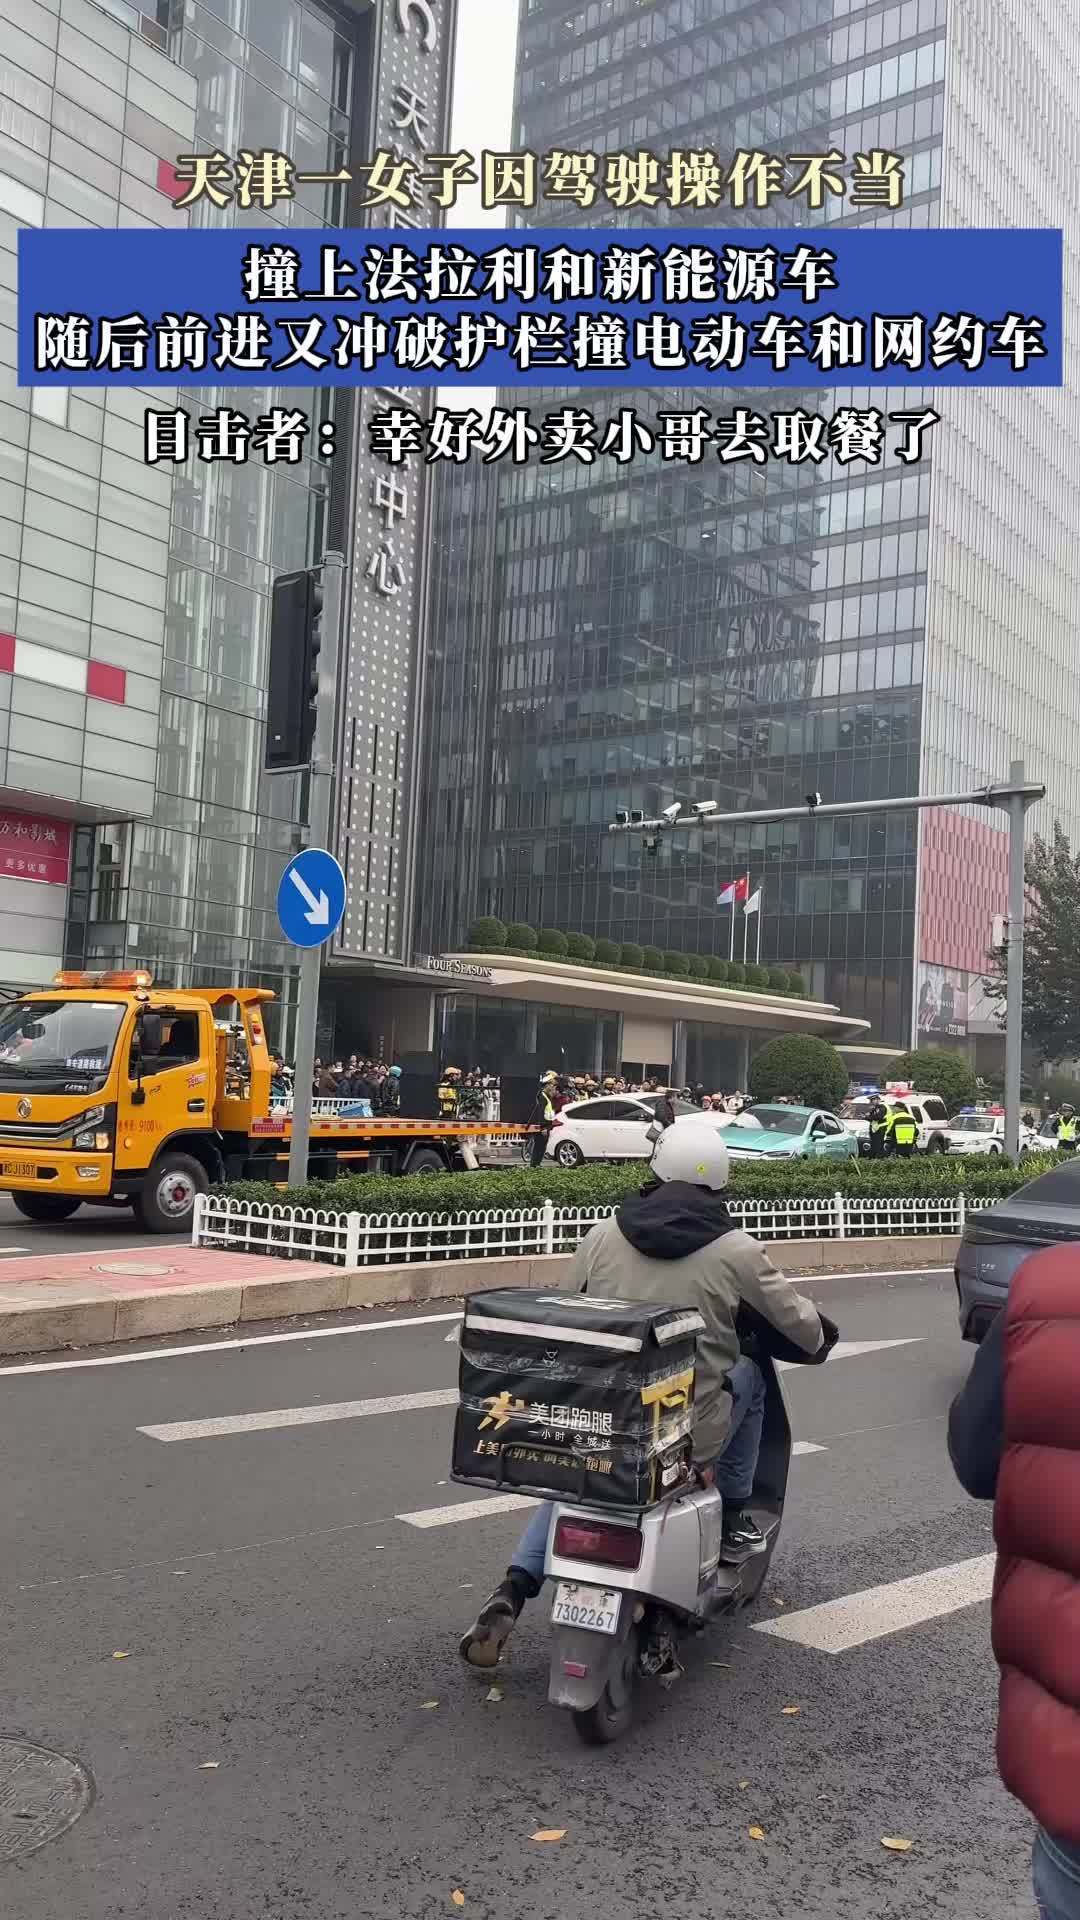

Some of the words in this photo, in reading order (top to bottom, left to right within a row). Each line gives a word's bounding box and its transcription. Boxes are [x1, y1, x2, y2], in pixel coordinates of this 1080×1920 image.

[528, 1401, 613, 1436] 美团跑腿
[556, 1602, 615, 1629] 7302267
